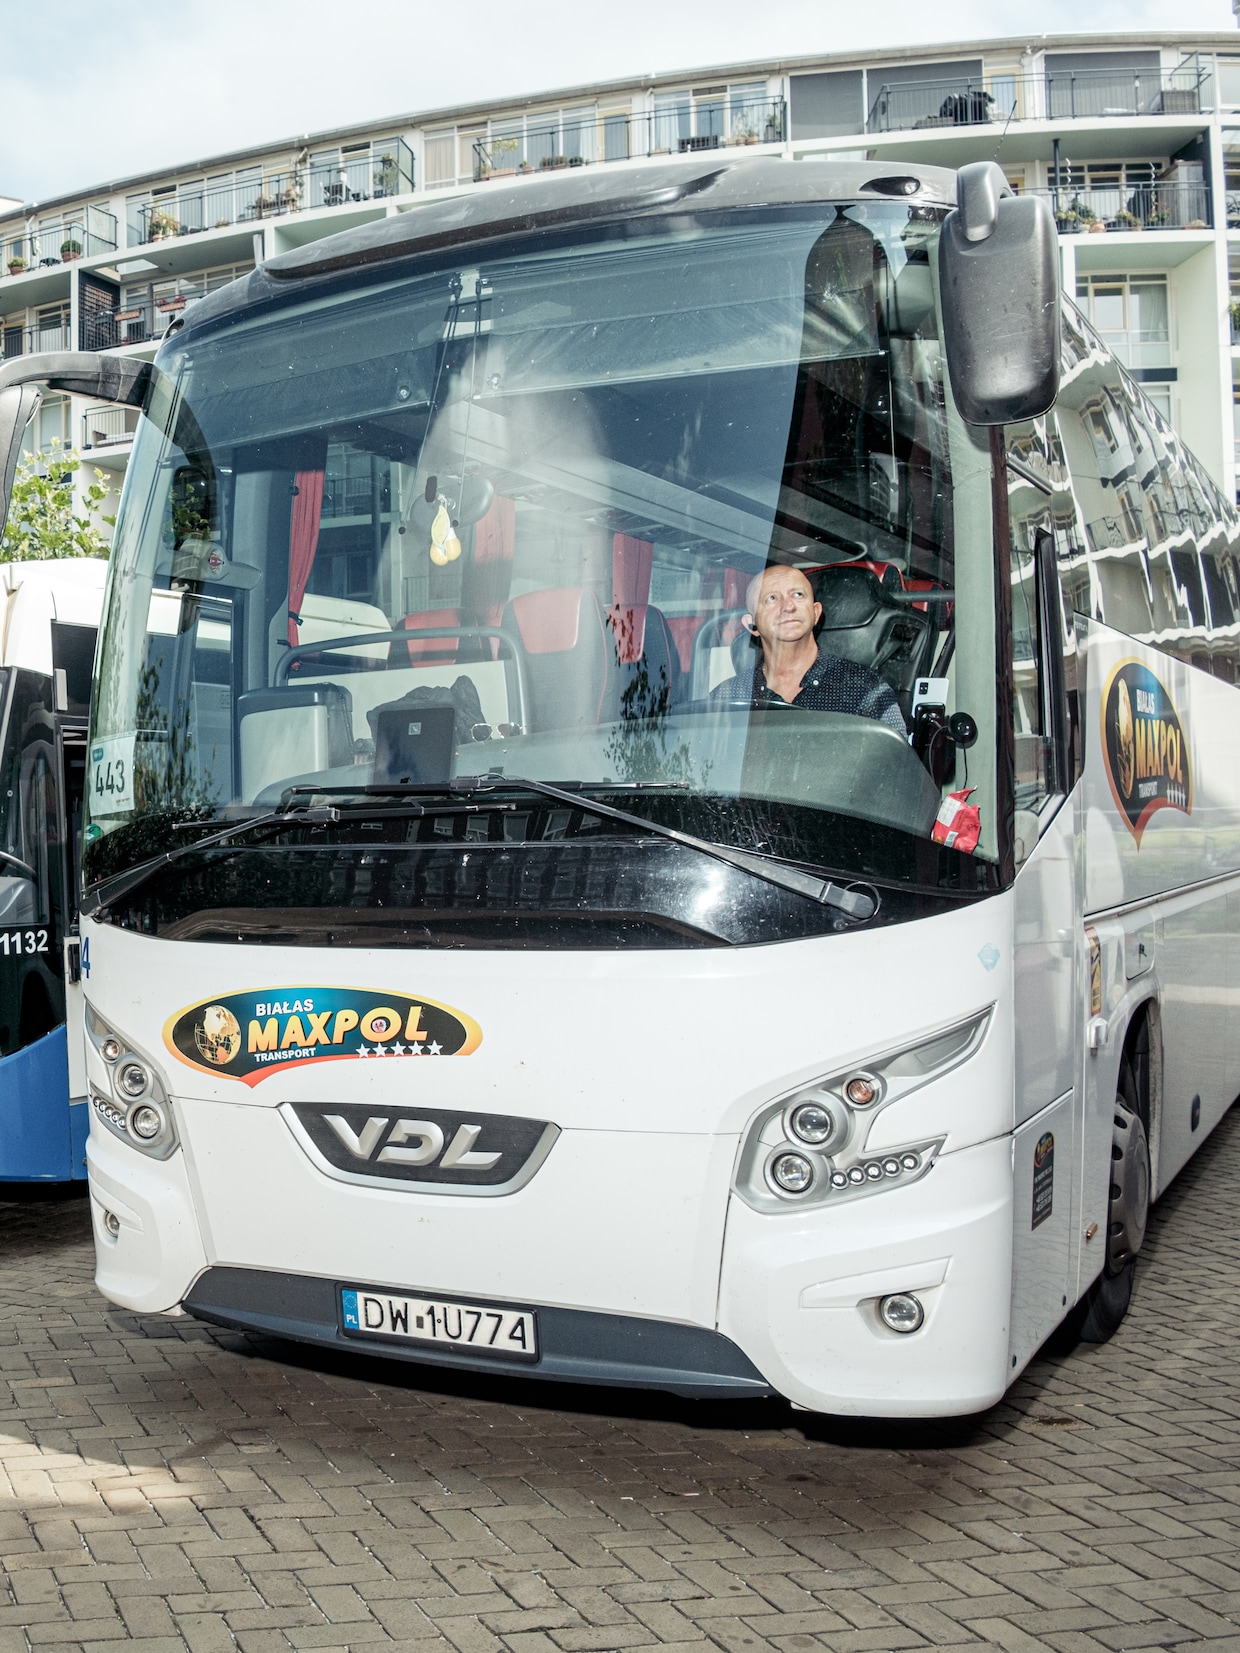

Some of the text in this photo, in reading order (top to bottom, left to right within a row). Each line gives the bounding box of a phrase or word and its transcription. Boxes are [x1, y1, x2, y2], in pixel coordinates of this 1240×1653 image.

[1135, 718, 1182, 784] MAXPOL
[95, 759, 125, 797] 443
[256, 999, 314, 1016] BIAŁAS
[248, 1006, 428, 1053] MAXPOL
[254, 1047, 316, 1062] TRANSPORT
[322, 1114, 503, 1170] VDL
[346, 1314, 357, 1325] PL
[364, 1297, 527, 1350] DW 1U774
